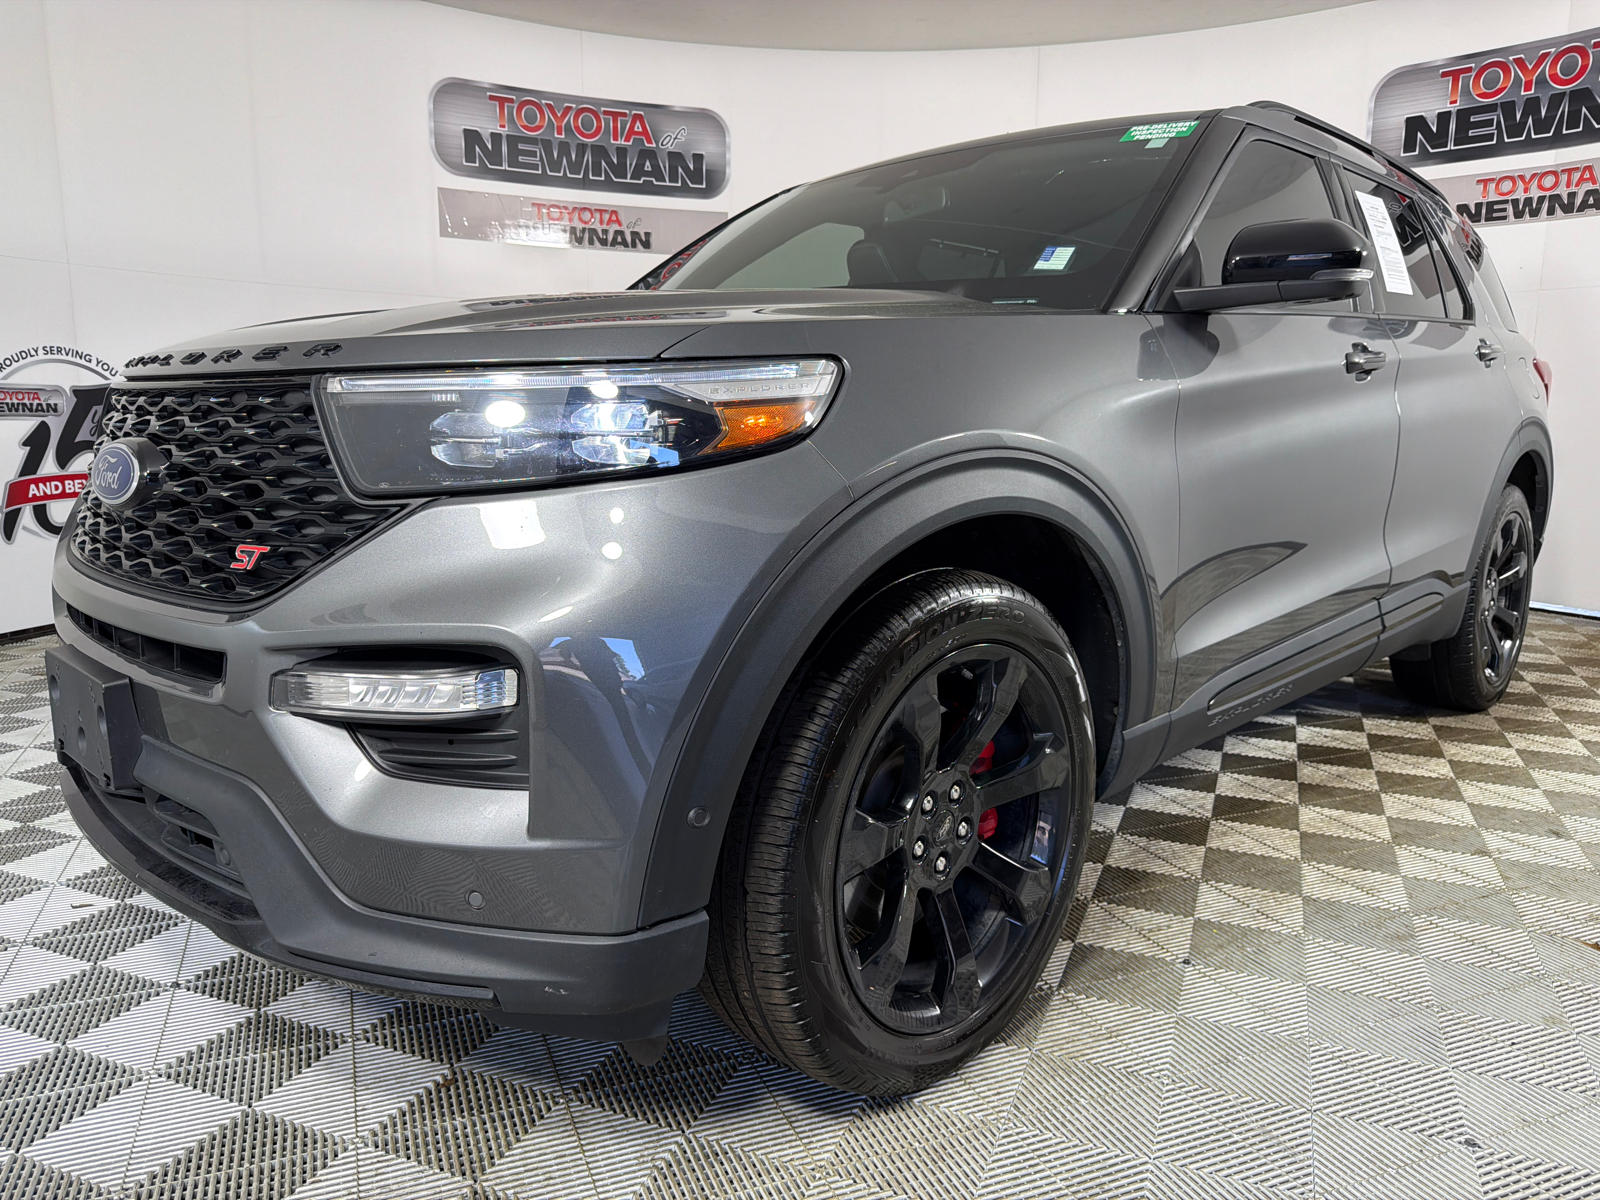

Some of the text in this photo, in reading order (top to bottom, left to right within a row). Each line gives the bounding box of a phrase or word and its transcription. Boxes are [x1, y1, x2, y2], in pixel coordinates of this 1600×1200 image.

[1440, 38, 1600, 107] TOYO
[487, 92, 687, 149] TOYOTA of
[1131, 121, 1198, 131] PRE-DELIVERY
[1131, 127, 1189, 136] INSPECTION
[1401, 86, 1600, 157] NEWN
[1133, 132, 1176, 140] PENDING
[462, 127, 706, 188] NEWNAN
[1476, 164, 1598, 199] TOYOTA
[531, 202, 642, 229] TOYOTA of
[1456, 188, 1600, 224] NEWNA
[560, 224, 652, 250] WNAN
[42, 345, 92, 363] SERVING
[96, 357, 119, 377] YOU
[123, 341, 343, 369] PLORER
[708, 382, 811, 395] EXPLORER
[95, 455, 123, 490] Ford
[28, 481, 63, 498] AND
[230, 545, 270, 569] ST
[966, 604, 1027, 624] ZERO
